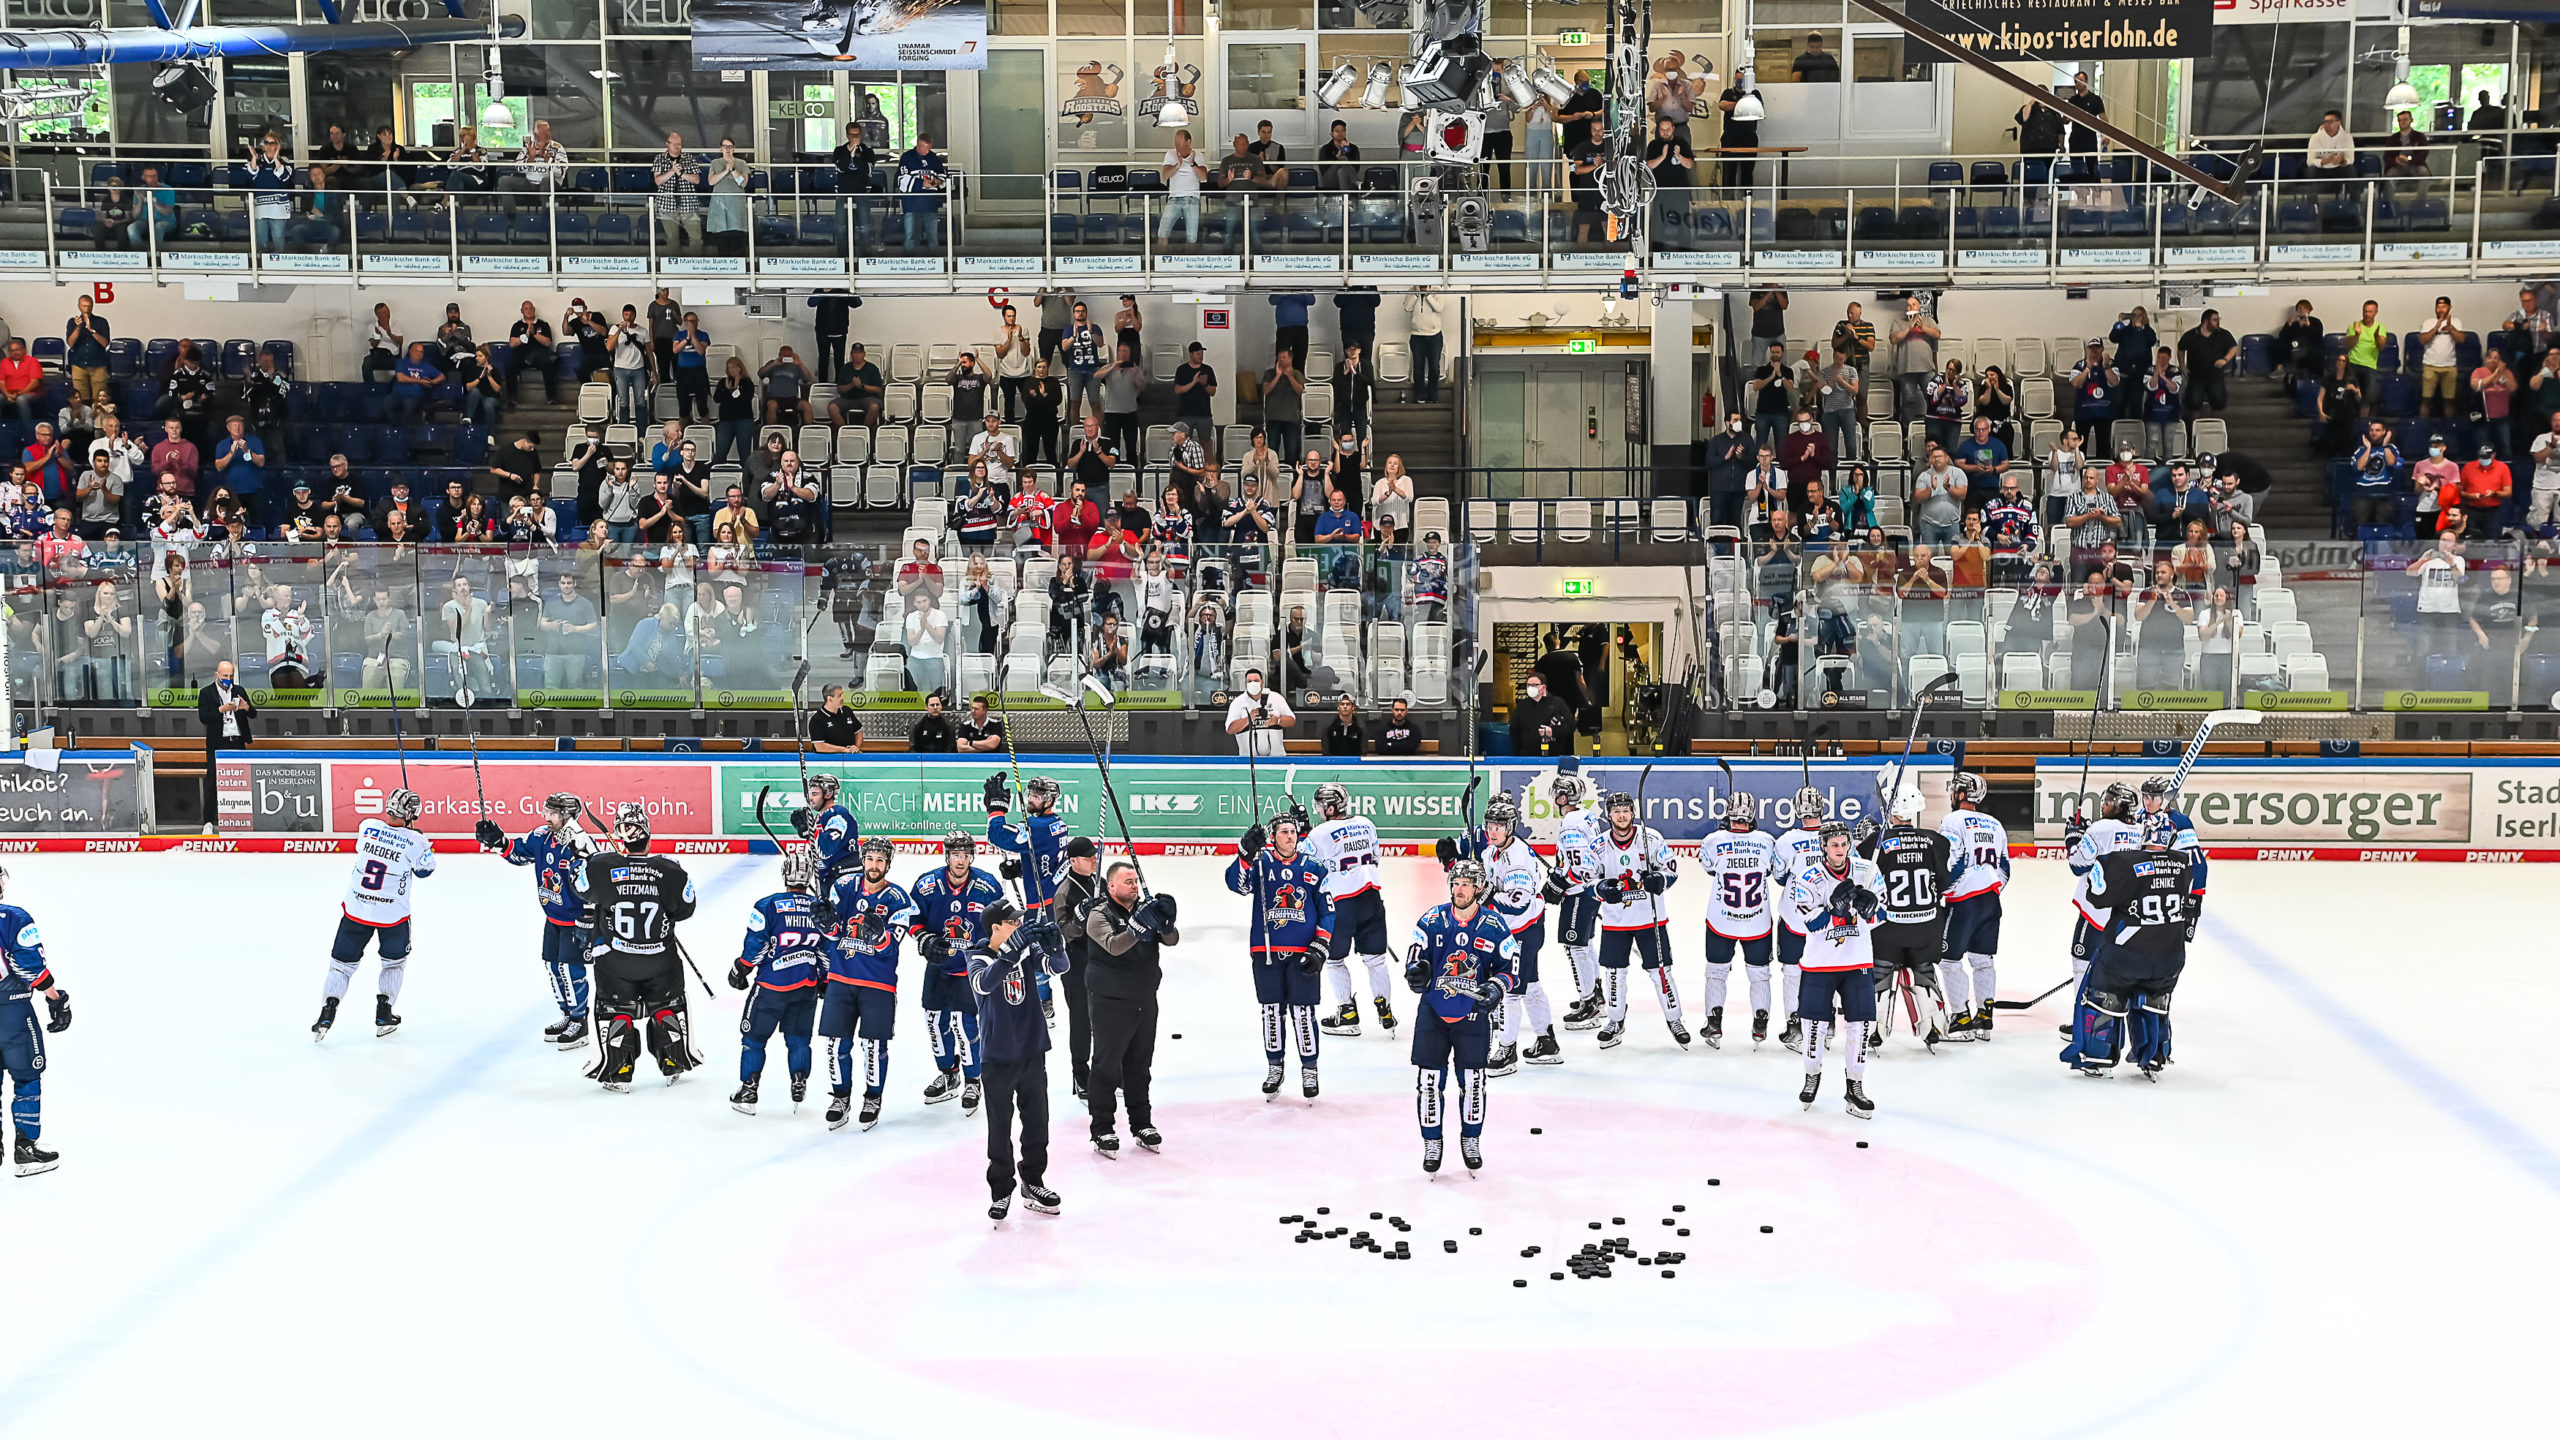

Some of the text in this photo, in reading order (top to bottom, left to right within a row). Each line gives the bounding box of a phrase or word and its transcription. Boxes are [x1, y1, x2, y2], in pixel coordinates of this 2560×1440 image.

[1941, 18, 2178, 56] www.kipos-iserlohn.de
[778, 102, 825, 118] KEUCO
[1063, 101, 1121, 116] ROOSTERS
[1097, 174, 1125, 184] KEUCO
[94, 281, 115, 304] B
[988, 286, 1009, 309] C
[639, 695, 687, 703] WARRIOR
[736, 695, 785, 703] WARRIOR
[869, 695, 918, 703] WARRIOR
[217, 768, 244, 777] rüster
[0, 772, 67, 794] rikot?
[217, 779, 248, 788] oosters
[278, 778, 316, 786] ISERLOHN
[217, 798, 252, 810] stagram
[419, 796, 513, 815] arkasse.
[924, 793, 984, 812] MEHR
[1130, 794, 1204, 815] IKZ
[60, 808, 94, 822] an.
[217, 818, 251, 827] dehaus
[864, 820, 957, 831] www.ikz-online.de
[1343, 839, 1370, 853] RAUSCH
[1733, 841, 1767, 850] Märkische
[1900, 836, 1934, 845] Märkische
[363, 841, 402, 864] RAEDEKE
[894, 844, 940, 855] ENNY.
[1727, 857, 1759, 868] ZIEGLER
[1896, 852, 1923, 864] NEFFIN
[2153, 860, 2186, 870] Märkische
[2155, 867, 2172, 875] Bank
[361, 859, 388, 891] 9
[1268, 868, 1276, 882] A
[1889, 868, 1932, 907] 20
[2150, 876, 2176, 889] JENIKE
[1723, 871, 1763, 908] 52
[1895, 909, 1935, 919] KIRCHHOFF
[2141, 893, 2185, 926] 92
[614, 901, 660, 940] 67
[1436, 934, 1443, 947] C
[1809, 1019, 1819, 1059] FERNHO
[1860, 1019, 1870, 1064] FERNHO
